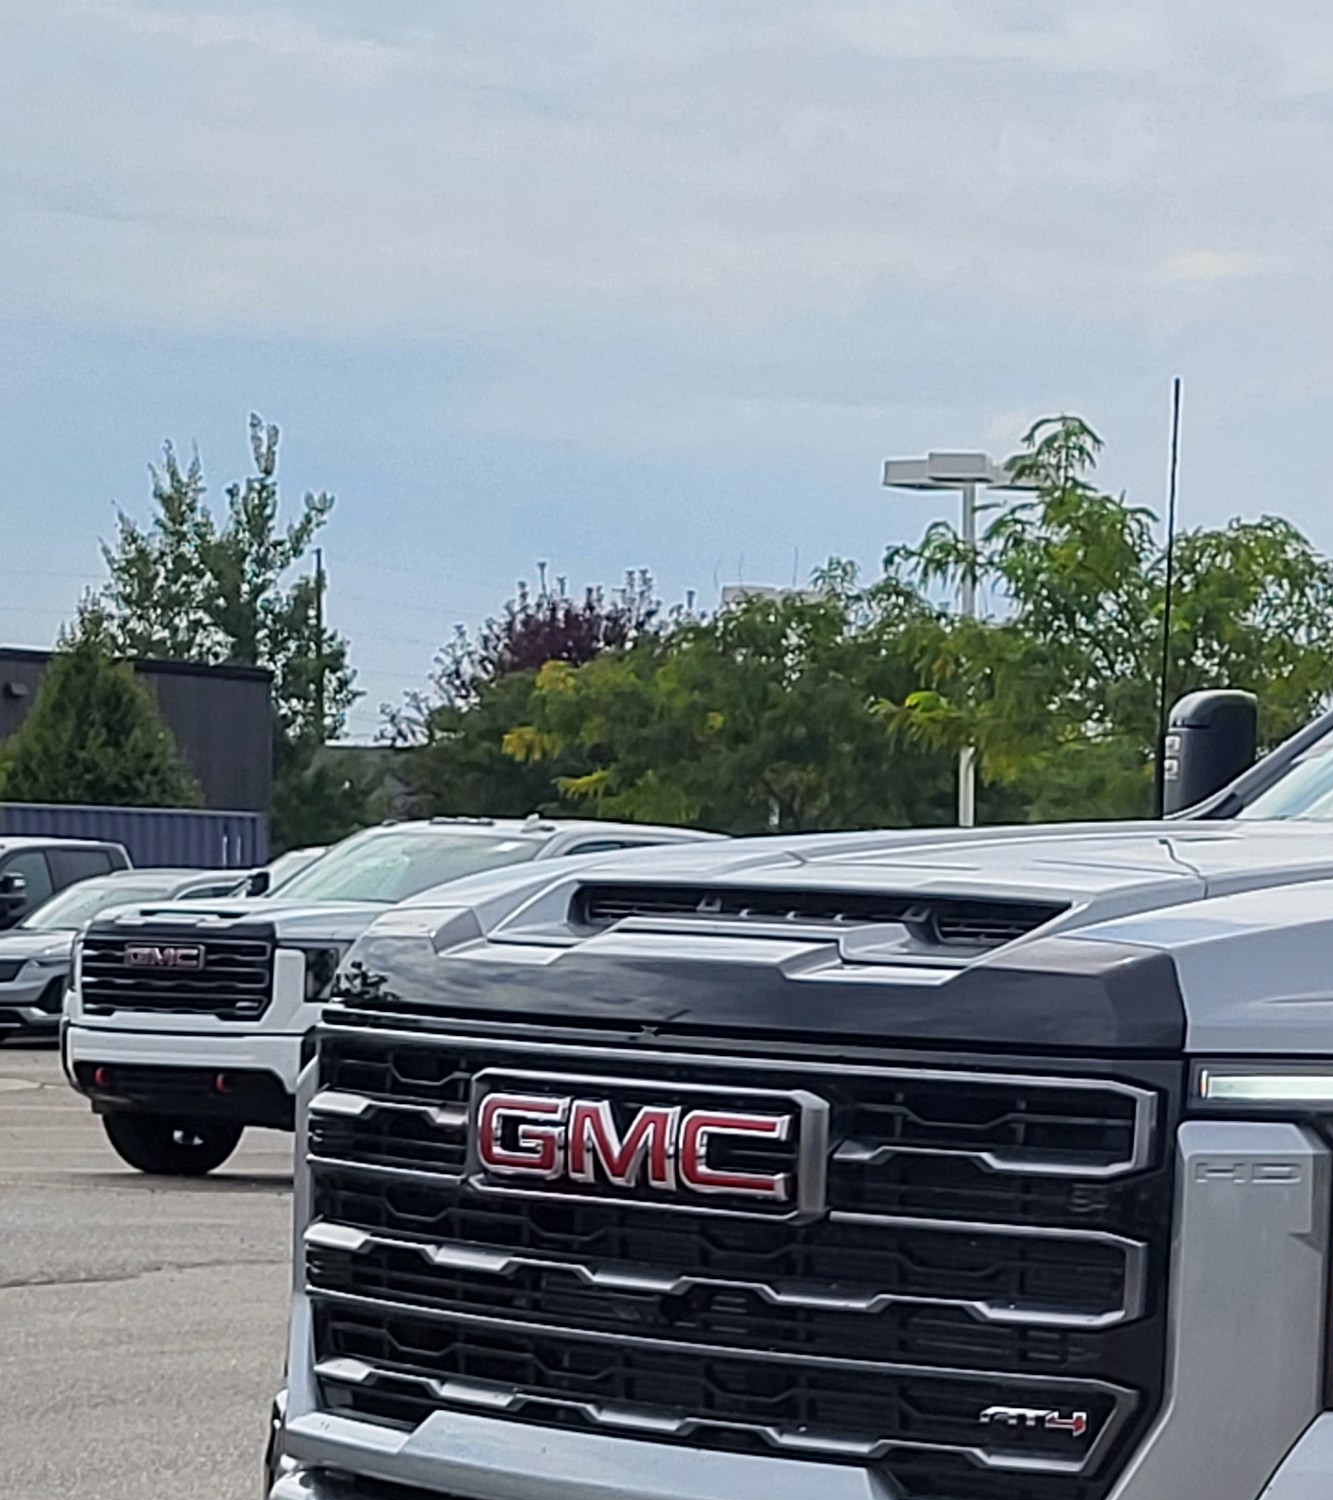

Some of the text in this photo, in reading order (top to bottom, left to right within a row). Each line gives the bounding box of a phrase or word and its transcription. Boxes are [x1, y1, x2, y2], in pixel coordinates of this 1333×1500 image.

[126, 946, 200, 968] GMC
[478, 1092, 793, 1201] GMC
[1193, 1161, 1302, 1185] HD
